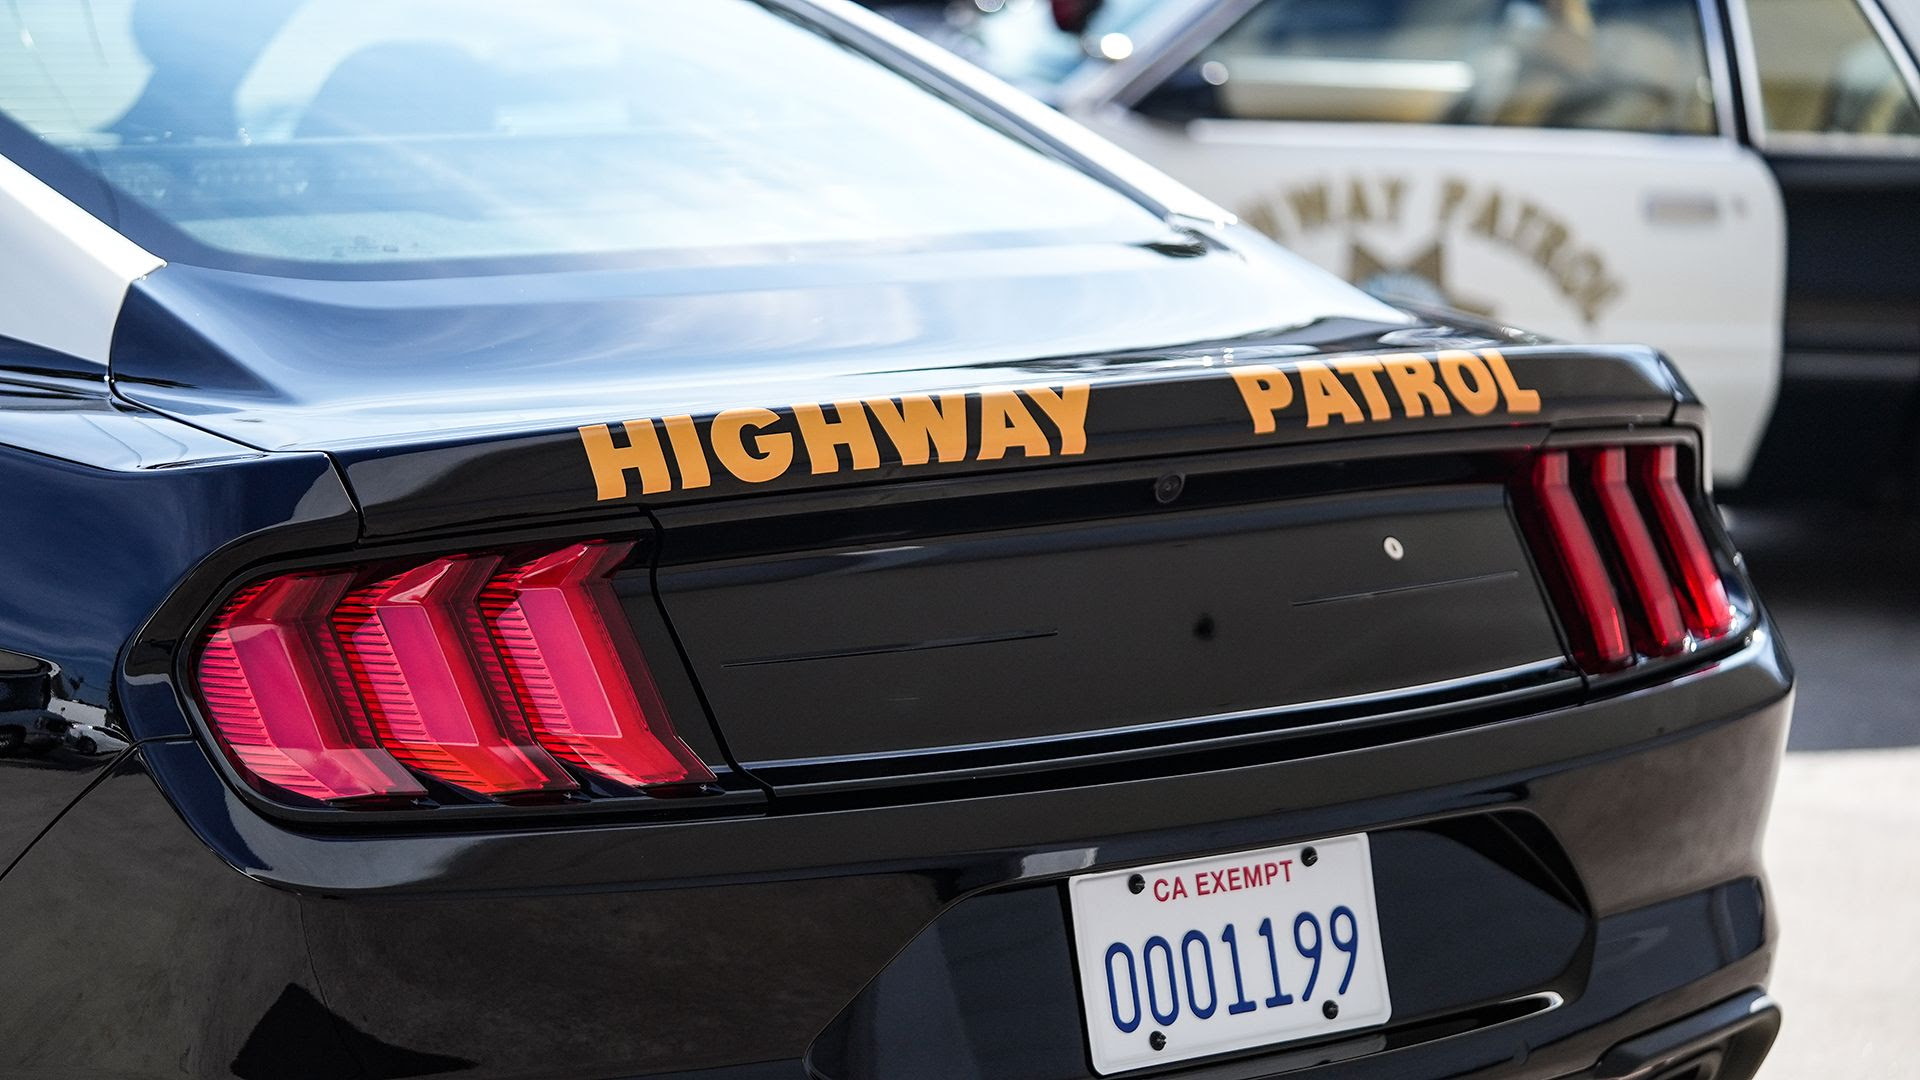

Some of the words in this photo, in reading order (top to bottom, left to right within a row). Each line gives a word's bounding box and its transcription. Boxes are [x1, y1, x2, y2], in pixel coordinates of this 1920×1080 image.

[1438, 174, 1621, 324] PATROL
[578, 384, 1091, 501] HIGHWAY
[1226, 348, 1541, 434] PATROL
[1153, 876, 1188, 902] CA
[1195, 859, 1293, 896] EXEMPT
[1105, 905, 1358, 1034] 0001199
